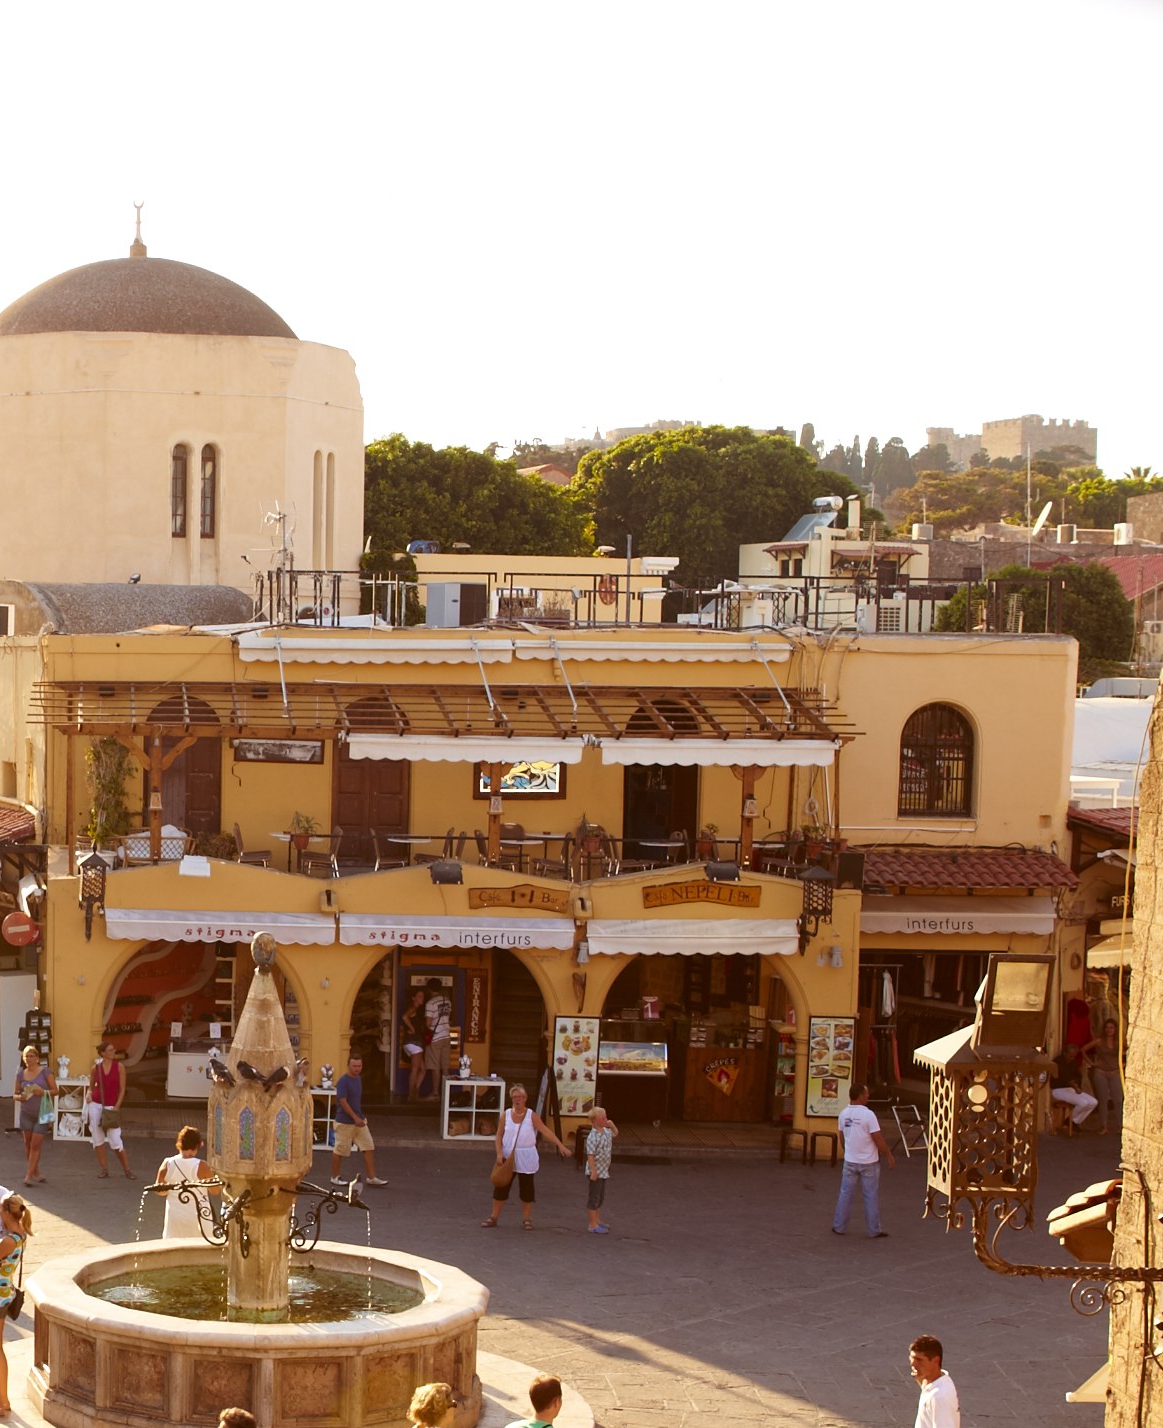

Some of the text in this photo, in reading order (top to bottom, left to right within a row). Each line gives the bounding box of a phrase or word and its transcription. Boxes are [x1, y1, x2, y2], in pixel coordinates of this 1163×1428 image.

[670, 885, 734, 903] NEPELI
[906, 917, 974, 931] interfurs
[184, 926, 256, 939] stigma
[368, 930, 531, 946] stigma interfurs
[470, 977, 481, 1036] ENTRANCE
